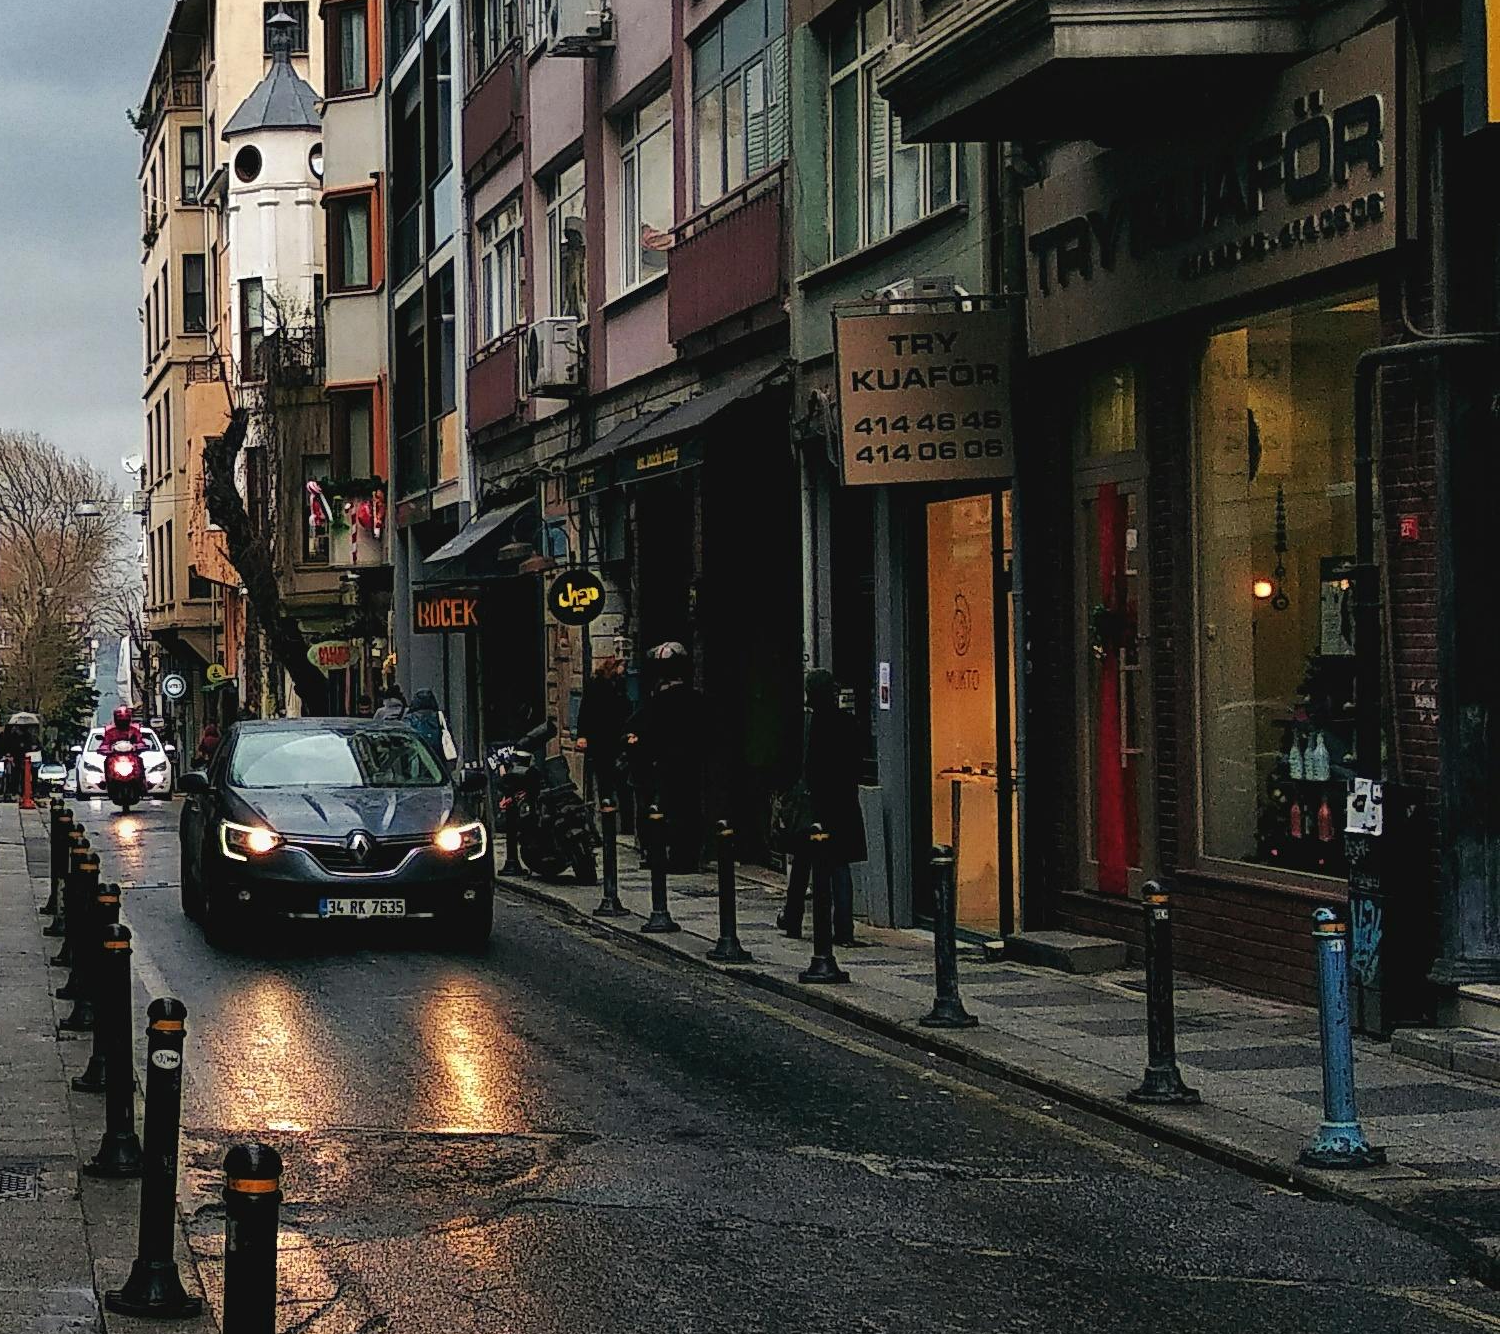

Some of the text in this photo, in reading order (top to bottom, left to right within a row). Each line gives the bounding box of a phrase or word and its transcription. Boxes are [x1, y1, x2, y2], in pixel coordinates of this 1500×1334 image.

[888, 331, 958, 356] TRY
[852, 358, 999, 392] KUAFÖR
[854, 410, 1002, 435] 414 46 46
[856, 438, 1004, 464] 414 06 06
[329, 900, 404, 914] 34 RK 7635
